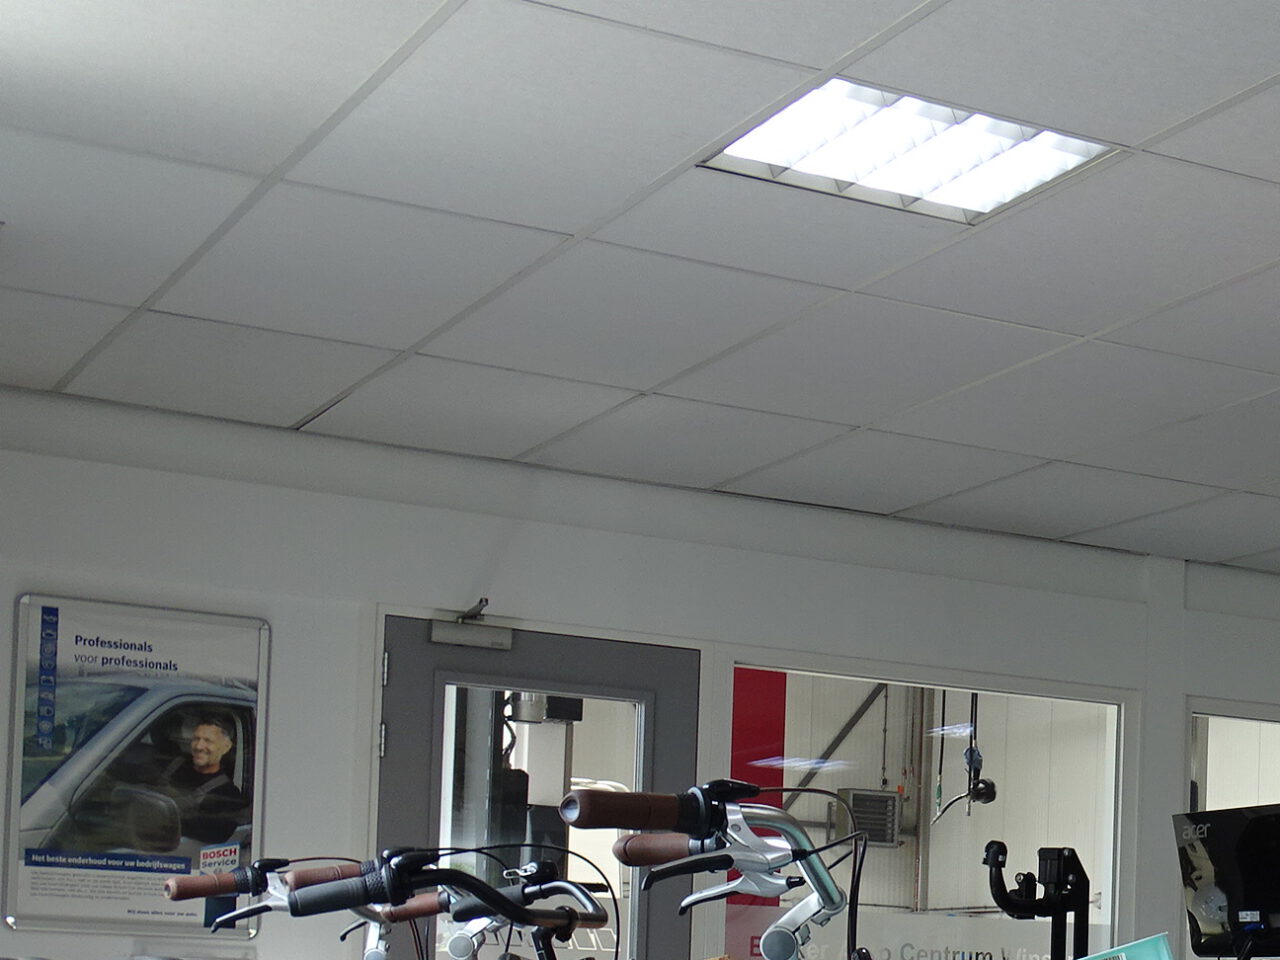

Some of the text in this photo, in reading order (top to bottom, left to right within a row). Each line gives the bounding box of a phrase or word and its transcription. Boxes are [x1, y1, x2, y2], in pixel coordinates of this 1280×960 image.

[75, 635, 153, 653] Professionals
[74, 654, 179, 671] voor professionals
[1182, 823, 1211, 840] acer
[202, 848, 237, 860] BOSCH
[201, 859, 237, 868] Service
